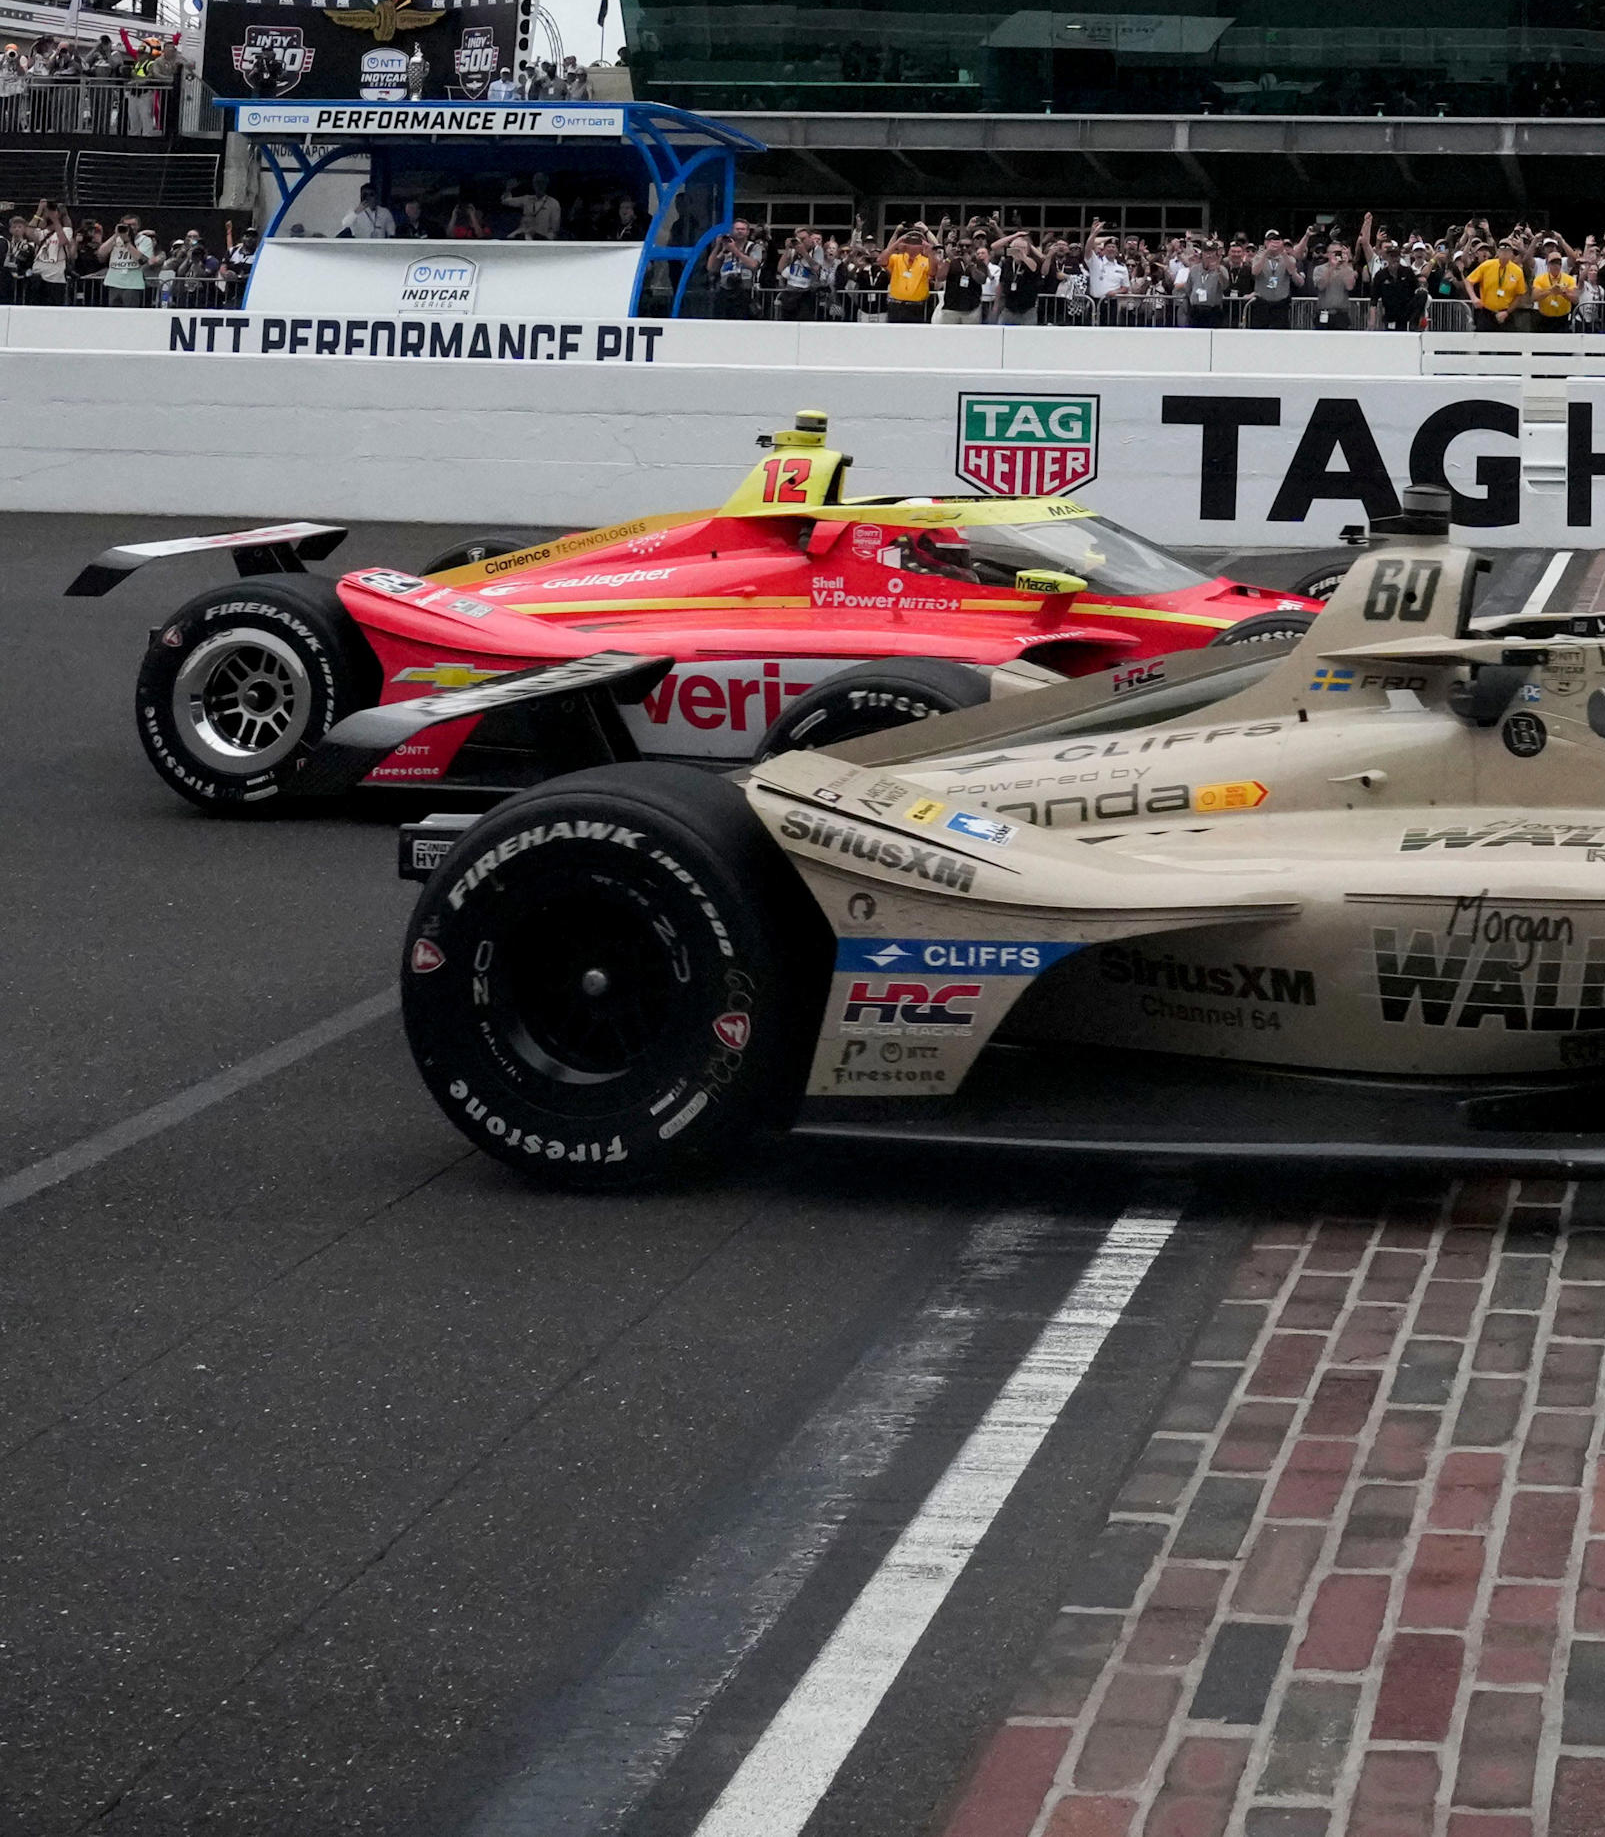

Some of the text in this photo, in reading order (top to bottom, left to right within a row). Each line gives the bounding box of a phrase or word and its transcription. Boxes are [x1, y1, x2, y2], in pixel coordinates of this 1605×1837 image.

[256, 34, 291, 48] INDY
[467, 35, 487, 49] INDY
[241, 48, 305, 72] 50
[380, 58, 404, 69] NTT
[460, 49, 492, 73] 500
[360, 73, 408, 83] INDYCAR
[262, 115, 282, 124] NTT
[316, 109, 543, 132] PERFORMANCE PIT
[566, 117, 588, 127] NTT
[432, 268, 468, 282] NTT
[400, 288, 471, 302] INDYCAR
[413, 301, 454, 309] SERIES
[168, 316, 251, 354] NTT
[596, 324, 664, 362] PIT
[970, 404, 1087, 440] TAG
[761, 458, 813, 504] 12
[483, 546, 551, 576] Clarience
[555, 520, 648, 557] TECHNOLOGIES
[541, 565, 679, 591] Gallagher
[811, 576, 845, 589] Shell
[1016, 576, 1062, 593] Mazak
[1308, 574, 1347, 596] FIRE
[811, 590, 897, 609] V-Power
[1362, 559, 1444, 623] 60
[203, 601, 324, 653] FIREHAWK
[1112, 661, 1167, 693] HRC
[640, 661, 817, 732] veri
[144, 705, 216, 799] Firestone
[407, 745, 431, 755] NTT
[1052, 722, 1286, 764] CLIFFS
[371, 766, 440, 777] Firestone
[945, 765, 1153, 797] Powered by
[779, 808, 980, 894] SiriusXM
[447, 819, 649, 911] FIREHAWK
[1446, 889, 1576, 973] Morgan
[923, 944, 1041, 970] CLIFFS
[1100, 944, 1318, 1006] SiriusXM
[841, 980, 986, 1028] HRC
[1140, 994, 1283, 1032] Channel 64
[904, 1025, 974, 1038] RACING
[832, 1066, 947, 1085] Firestone
[448, 1078, 630, 1164] Firestone
